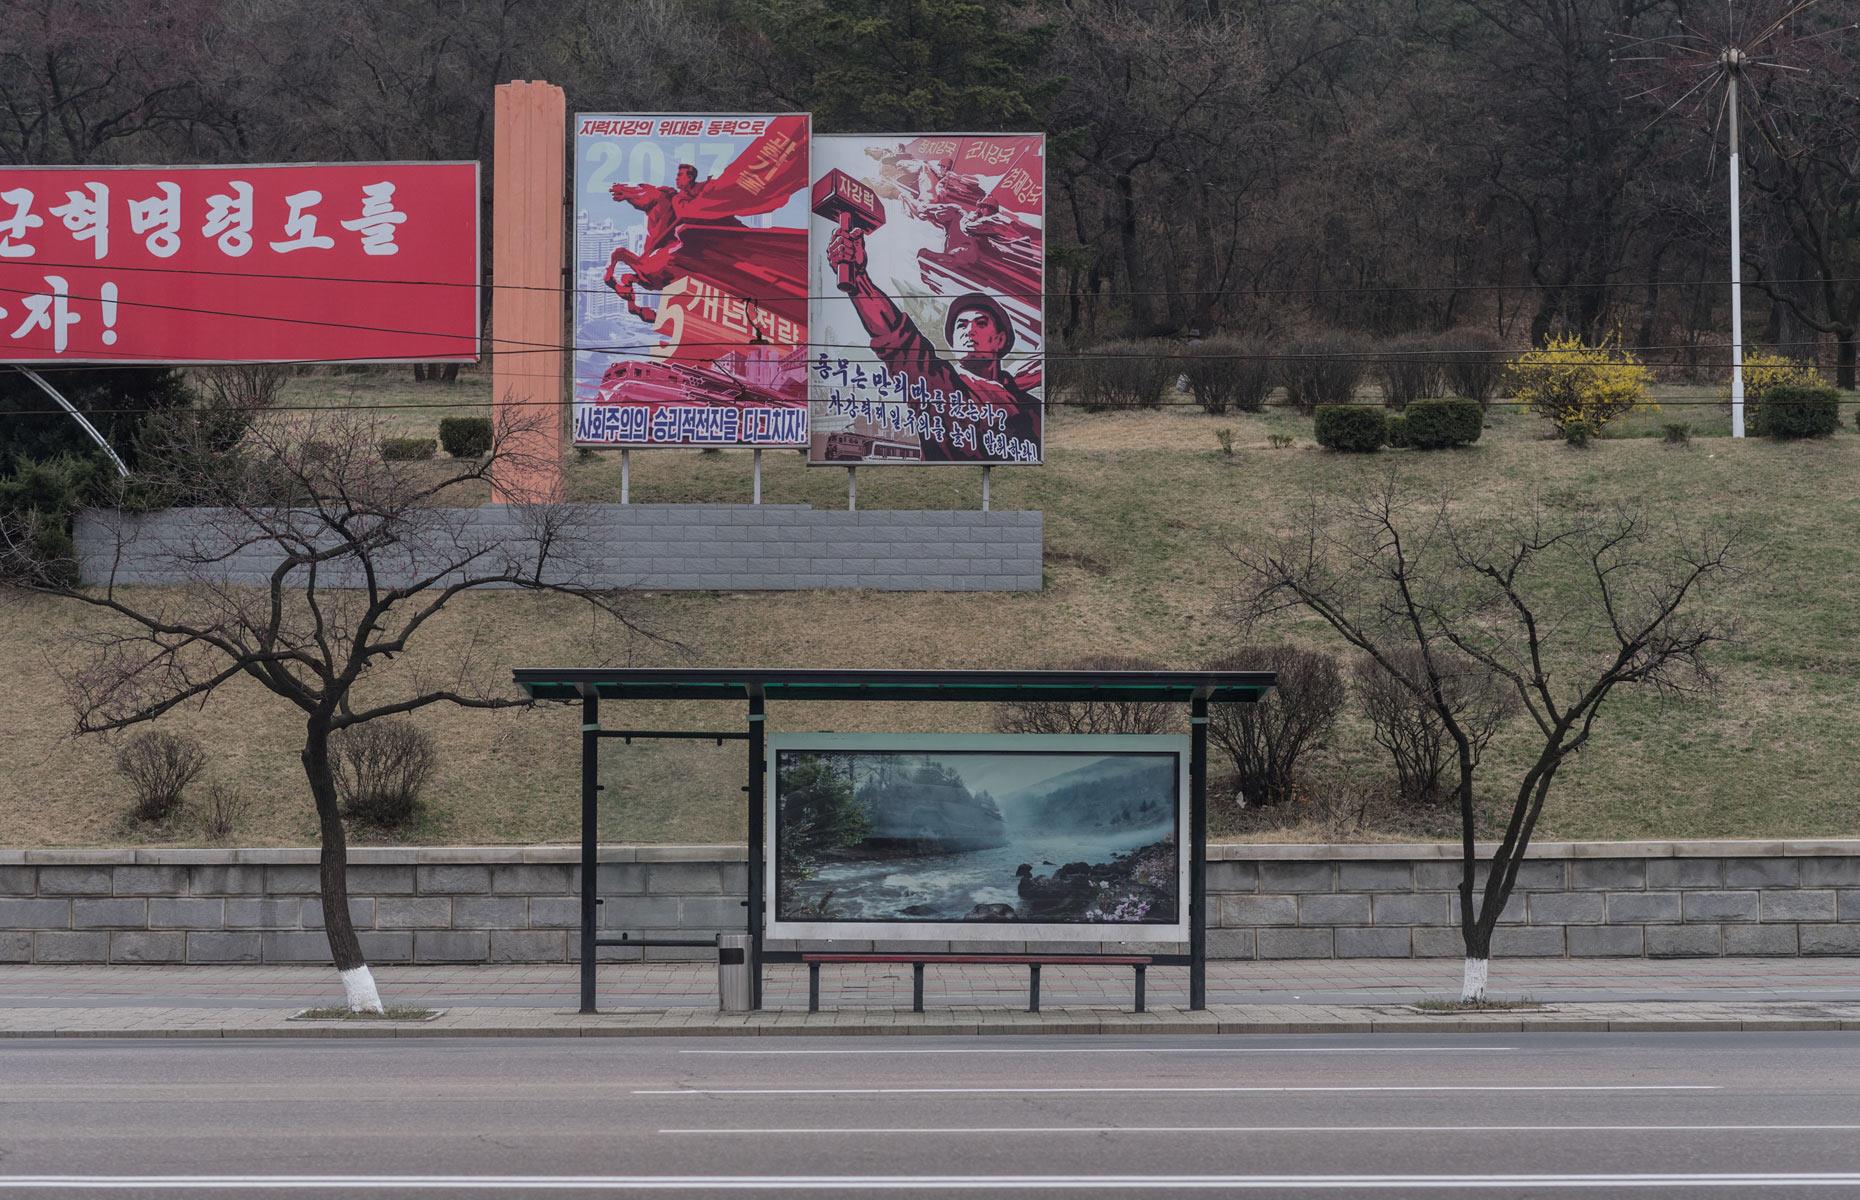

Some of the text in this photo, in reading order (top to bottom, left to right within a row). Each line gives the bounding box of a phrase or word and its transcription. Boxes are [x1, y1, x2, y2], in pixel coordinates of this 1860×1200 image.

[579, 120, 765, 136] 자력자강의 위대한 동력으로
[585, 141, 735, 194] 2017
[964, 140, 1015, 165] 군사강국
[839, 176, 874, 212] 자강력
[1001, 167, 1042, 205] 경제강국
[0, 180, 408, 260] 군혁명령도를
[0, 275, 118, 354] 자!
[812, 353, 1007, 431] 동무는 만리마를 탔는가?
[577, 407, 807, 441] 사회주의의 승리적전진을 다그치자!
[828, 389, 1038, 462] 자강력제일주의를 높이 발휘하라!
